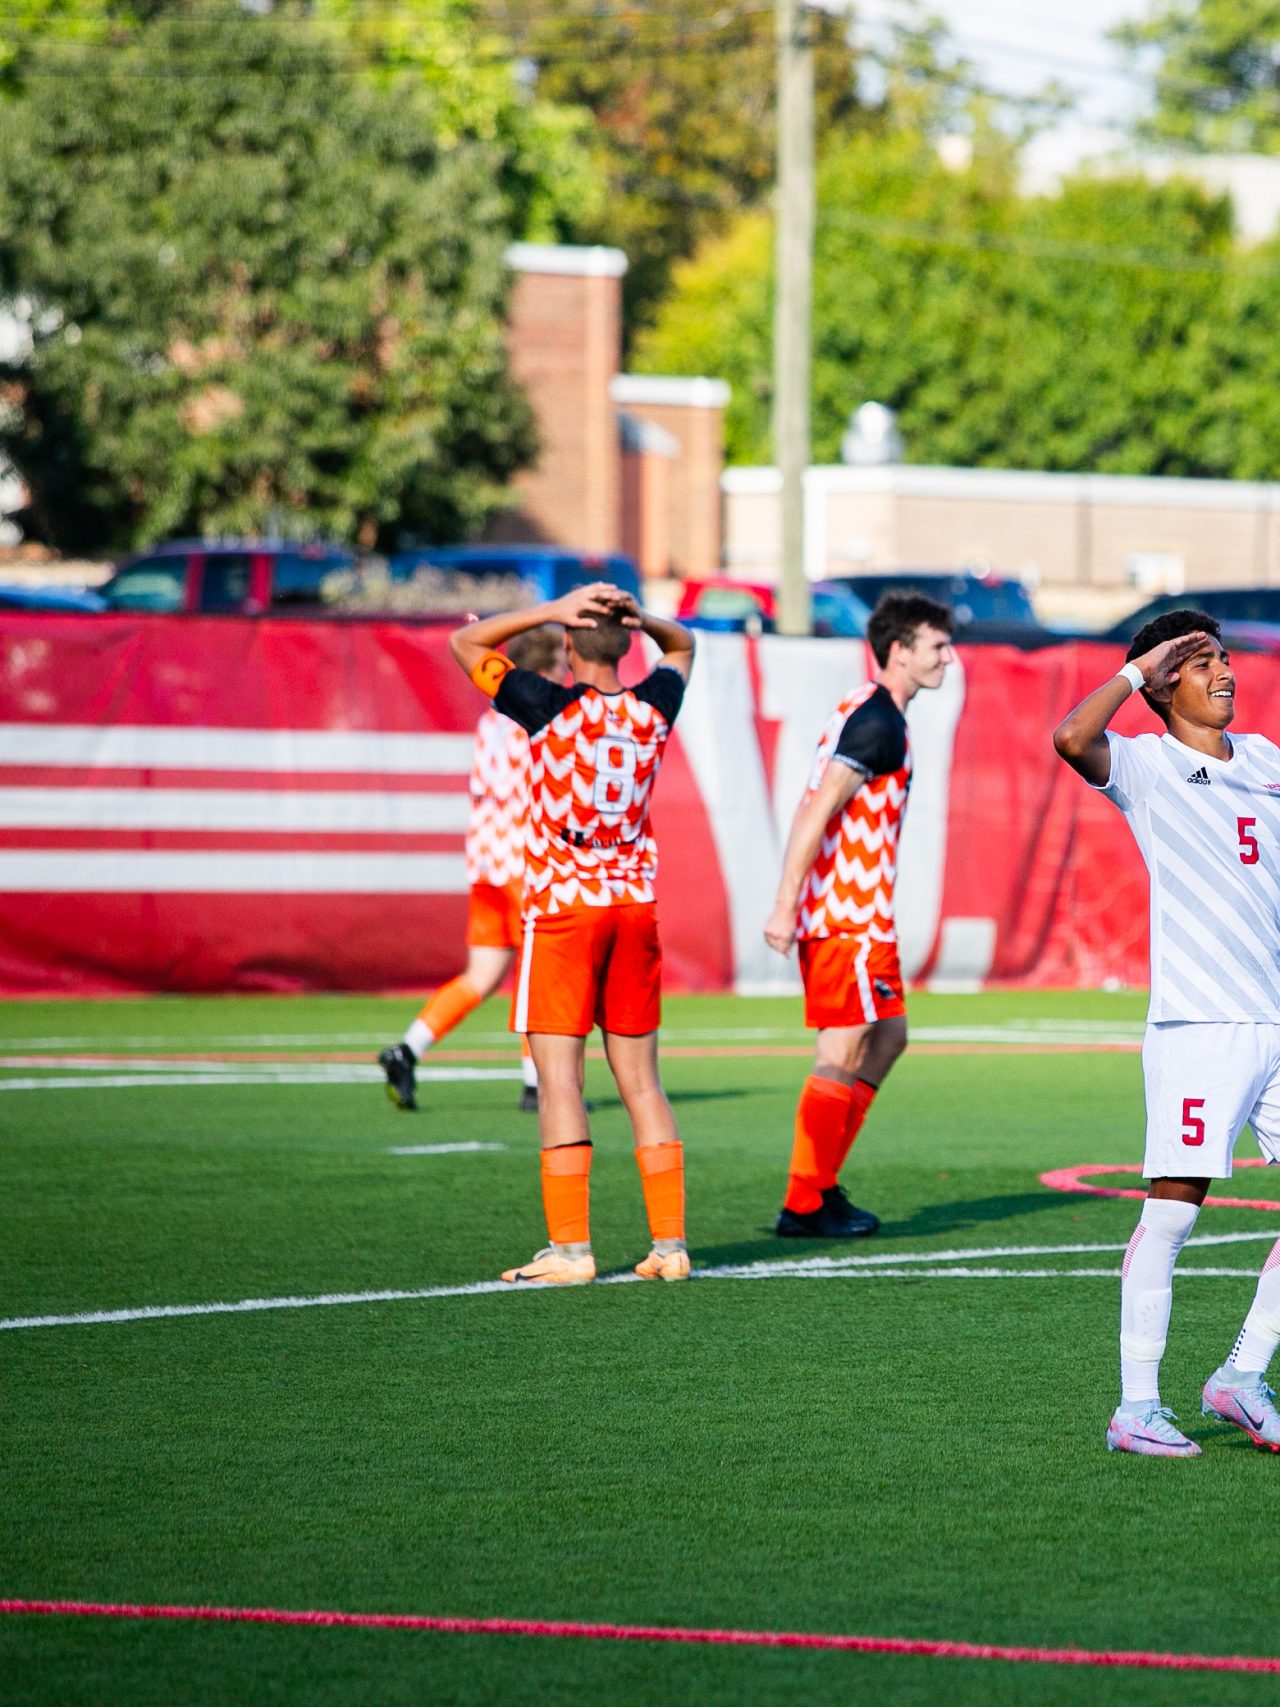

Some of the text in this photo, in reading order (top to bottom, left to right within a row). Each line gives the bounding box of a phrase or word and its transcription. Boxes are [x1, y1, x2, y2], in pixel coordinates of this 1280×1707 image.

[592, 735, 637, 814] 8
[1237, 817, 1260, 865] 5
[1182, 1098, 1206, 1147] 5
